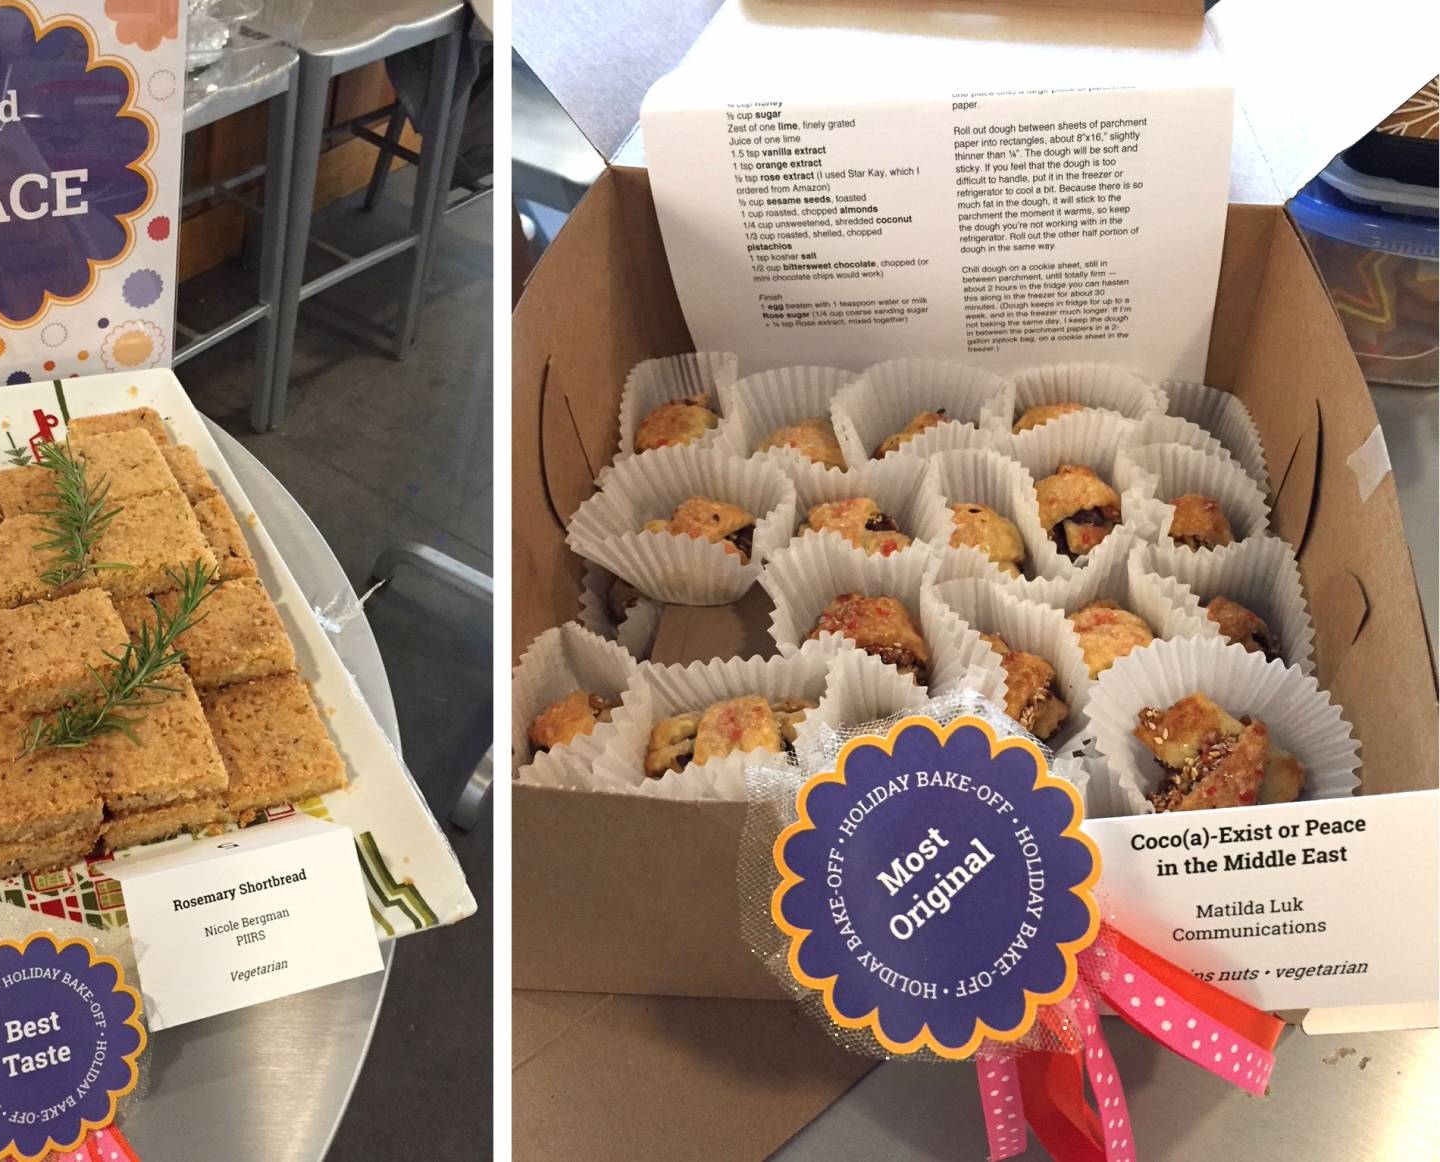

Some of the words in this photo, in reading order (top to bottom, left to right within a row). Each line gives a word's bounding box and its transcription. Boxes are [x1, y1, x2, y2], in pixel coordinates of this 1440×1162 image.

[737, 113, 753, 121] cup
[755, 112, 781, 121] sugar
[728, 123, 747, 132] Zest
[748, 123, 757, 131] of
[778, 122, 800, 132] lime,
[802, 121, 826, 131] finely
[827, 120, 856, 130] grated
[953, 126, 971, 135] Roll
[972, 125, 987, 134] out
[988, 124, 1016, 135] dough
[1018, 122, 1056, 132] between
[1057, 121, 1087, 130] sheets
[1089, 120, 1098, 129] of
[1100, 118, 1147, 130] parchment
[729, 136, 752, 145] Juice
[754, 136, 762, 144] of
[782, 135, 801, 143] lime
[954, 140, 979, 149] paper
[981, 138, 998, 146] into
[999, 136, 1047, 148] rectangles,
[1049, 134, 1075, 144] about
[1109, 132, 1140, 143] slightly
[746, 148, 760, 159] tsp
[762, 147, 792, 156] vanilla
[794, 146, 826, 155] extract
[954, 151, 984, 160] thinner
[986, 150, 1006, 159] than
[1026, 148, 1042, 157] The
[1043, 147, 1071, 158] dough
[1073, 146, 1087, 155] will
[1089, 146, 1101, 154] be
[1103, 145, 1119, 154] soft
[1121, 144, 1138, 153] and
[740, 161, 754, 172] tsp
[756, 162, 788, 171] orange
[790, 159, 822, 168] extract
[955, 163, 982, 174] sticky.
[985, 163, 991, 171] If
[993, 164, 1009, 173] you
[1010, 162, 1027, 170] feel
[1028, 161, 1045, 170] that
[1047, 160, 1061, 169] the
[1063, 159, 1091, 170] dough
[1092, 159, 1100, 167] is
[1102, 158, 1116, 167] too
[744, 173, 758, 184] tsp
[783, 171, 815, 180] extract
[824, 170, 846, 179] used
[848, 169, 865, 178] Star
[868, 169, 887, 179] Kay,
[890, 168, 914, 176] which
[736, 185, 769, 194] ordered
[770, 184, 790, 193] from
[792, 183, 831, 194] Amazon)
[749, 199, 764, 208] cup
[803, 195, 833, 206] seeds,
[835, 194, 867, 203] toasted
[748, 211, 764, 219] cup
[765, 208, 797, 219] roasted,
[801, 206, 838, 218] chopped
[839, 205, 878, 214] almonds
[744, 220, 756, 229] 1/4
[758, 222, 774, 230] cup
[775, 218, 832, 230] unsweetened,
[835, 216, 874, 226] shredded
[876, 215, 912, 224] coconut
[759, 233, 776, 241] cup
[777, 230, 810, 241] roasted,
[813, 229, 845, 240] shelled,
[846, 228, 883, 239] chopped
[747, 242, 792, 253] pistachios
[960, 244, 986, 254] dough
[988, 244, 996, 252] in
[997, 243, 1011, 251] the
[1038, 244, 1057, 252] way.
[752, 264, 764, 272] 1/2
[766, 265, 782, 273] cup
[783, 262, 832, 271] bittersweet
[833, 260, 878, 271] chocolate,
[880, 259, 916, 269] chopped
[917, 258, 928, 268] (or
[756, 253, 770, 263] tsp
[771, 253, 798, 261] kosher
[801, 252, 817, 260] salt
[754, 274, 770, 282] mini
[772, 272, 811, 281] chocolate
[812, 272, 834, 282] chips
[836, 271, 860, 279] would
[861, 270, 884, 280] work)
[839, 773, 911, 838] HOLIDAY
[916, 771, 1015, 817] BAKE-OFF
[1130, 823, 1273, 851] Coco(a)-Exist
[1278, 823, 1300, 838] or
[1304, 818, 1367, 836] Peace
[876, 827, 950, 897] Most
[1156, 859, 1179, 877] in
[1184, 857, 1218, 875] the
[1223, 850, 1297, 872] Middle
[1301, 846, 1348, 866] East
[1014, 826, 1045, 920] HOLIDAY
[172, 887, 237, 912] Rosemary
[238, 868, 308, 896] Shortbread
[889, 838, 996, 941] Original
[827, 848, 863, 952] BAKE-OFF
[1195, 899, 1265, 919] Matilda
[1270, 897, 1304, 914] Luk
[204, 920, 240, 938] Nicole
[241, 907, 290, 931] Bergman
[1172, 920, 1328, 942] Communications
[236, 930, 267, 947] PIIRS
[955, 922, 1038, 998] BAKE-OFF
[230, 959, 289, 983] Vegetarian
[857, 951, 938, 1000] HOLIDAY
[1218, 968, 1259, 983] nuts
[1274, 960, 1369, 981] vegetarian
[2, 967, 61, 989] HOLIDAY
[61, 972, 108, 1029] BAKE-OFF
[4, 1011, 61, 1044] Best
[2, 1045, 72, 1078] Taste
[78, 1040, 108, 1100] HOLIDAY
[8, 1095, 77, 1125] BAKE-OFF
